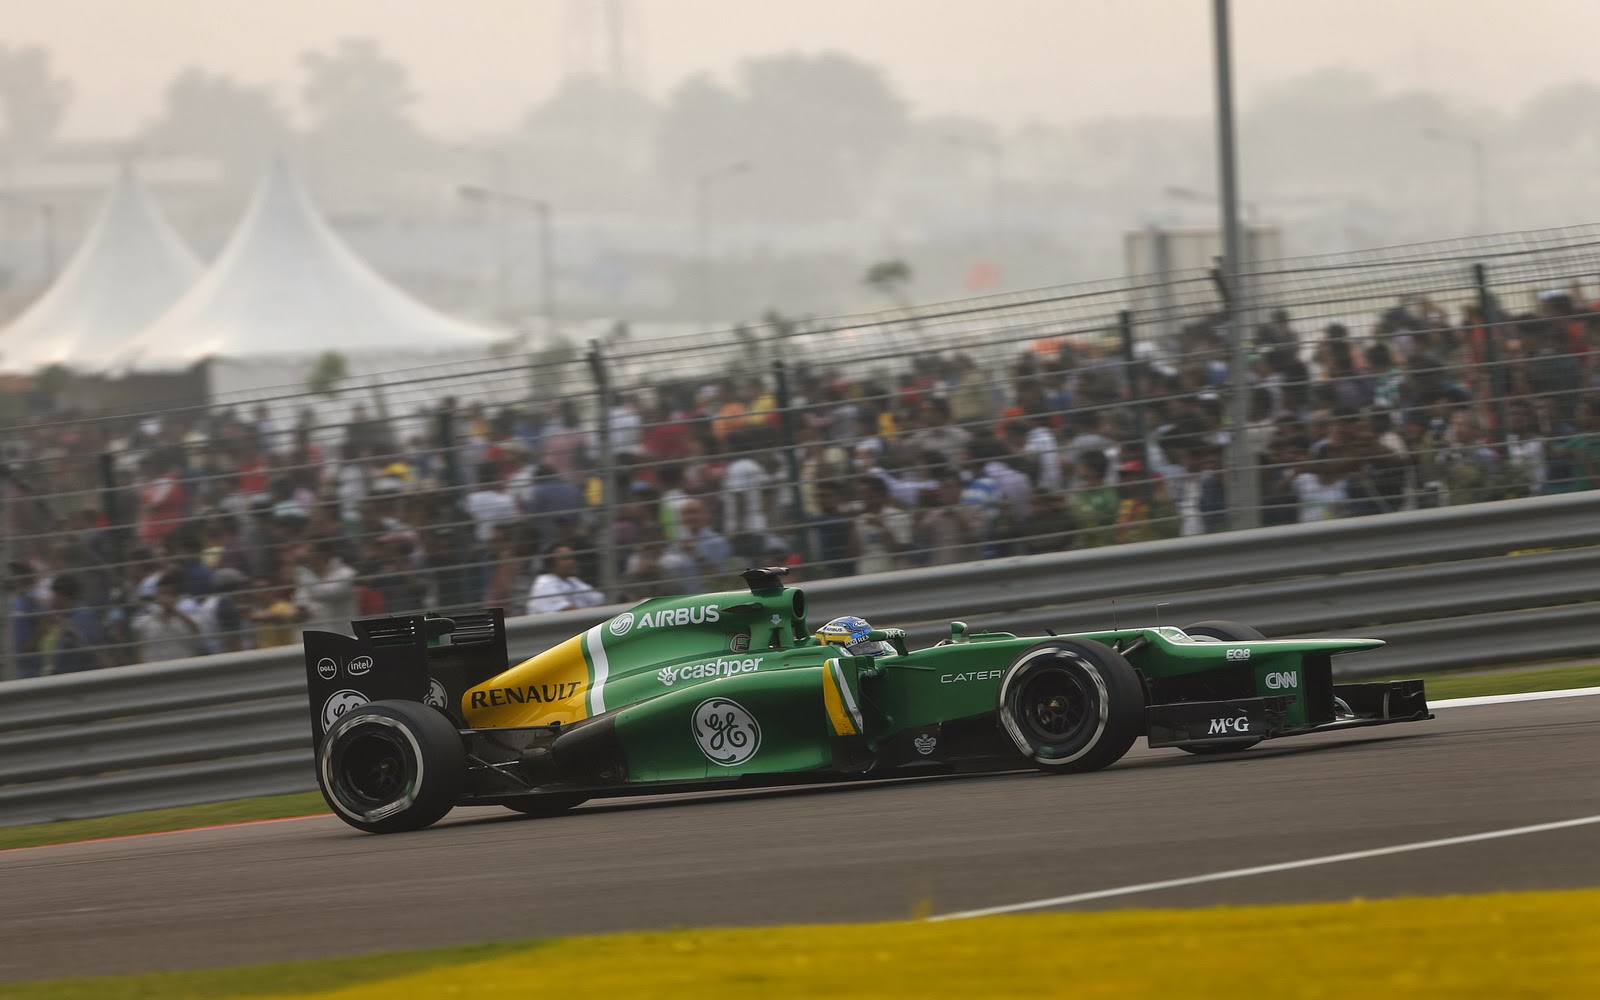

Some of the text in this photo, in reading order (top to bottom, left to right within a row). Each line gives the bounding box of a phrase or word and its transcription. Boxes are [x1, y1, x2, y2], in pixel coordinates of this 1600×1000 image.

[636, 604, 720, 629] AIRBUS
[1226, 648, 1251, 659] EQ8
[350, 659, 370, 670] intel
[679, 657, 764, 680] cashper
[940, 669, 1005, 684] CATER
[1265, 671, 1298, 689] CNN
[470, 681, 581, 709] RENAULT
[1207, 716, 1250, 735] McG
